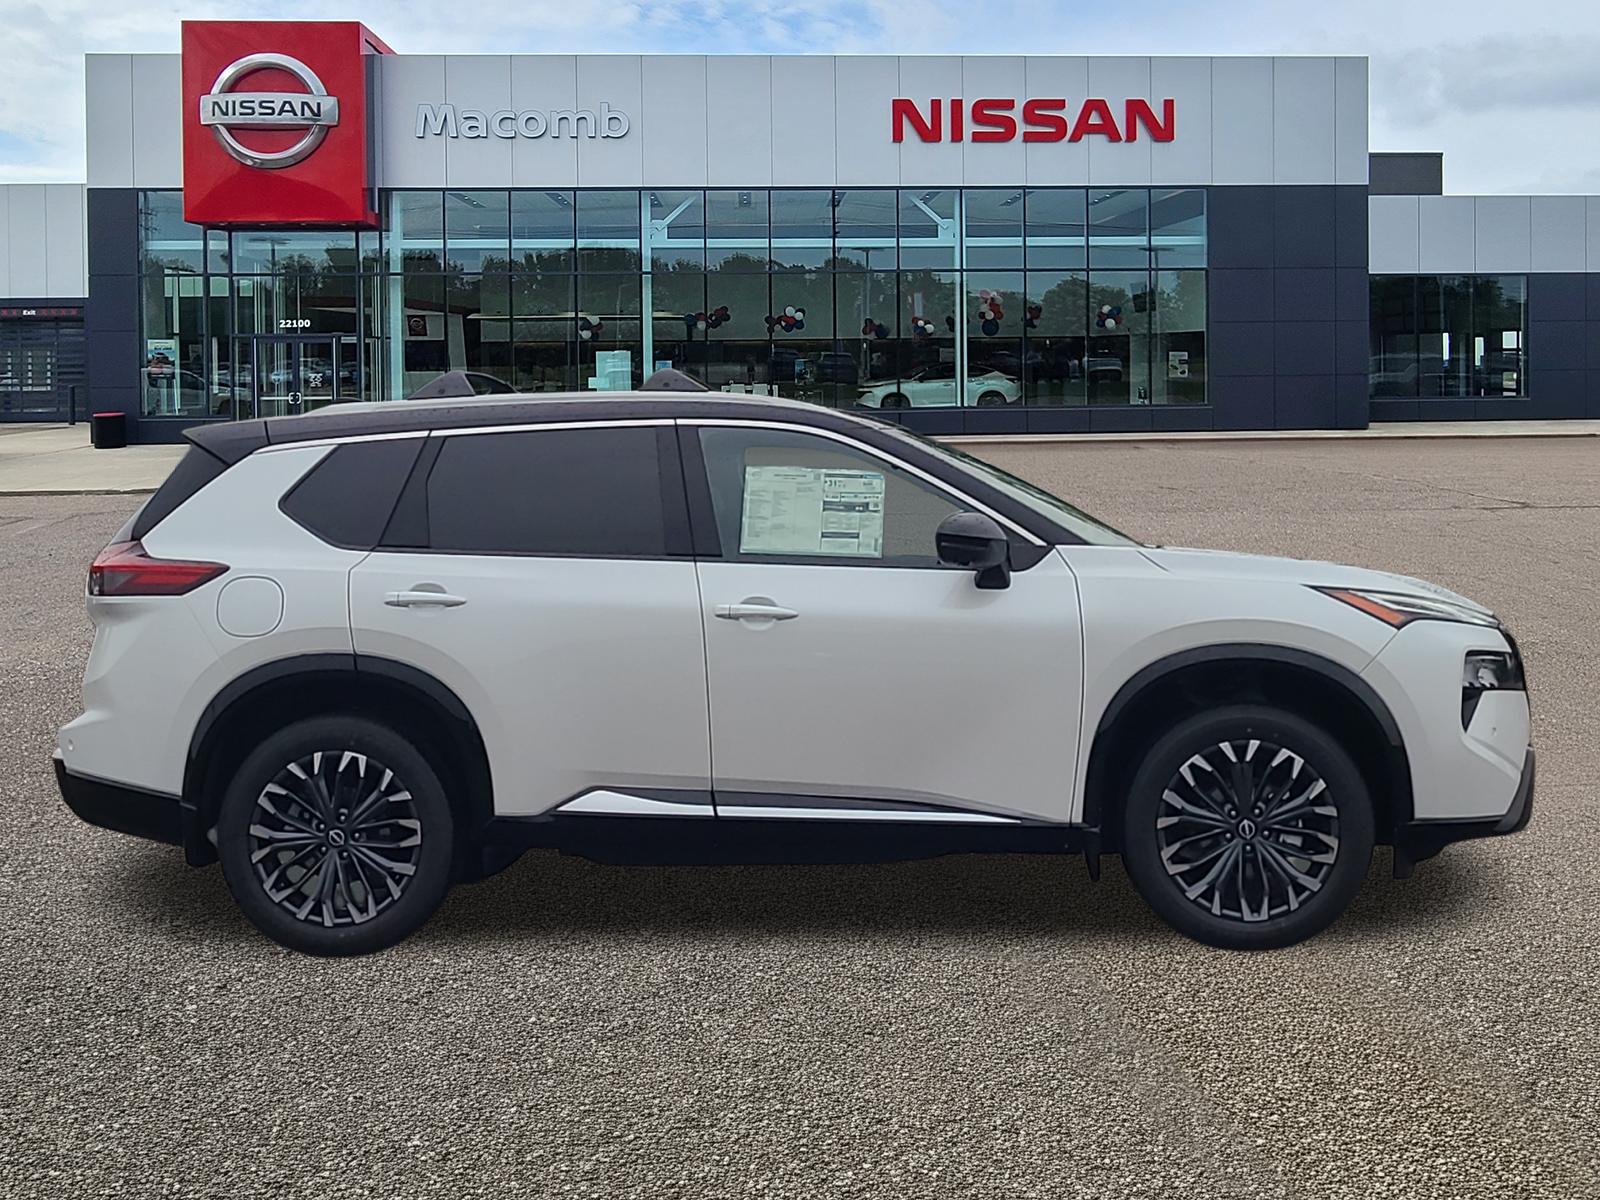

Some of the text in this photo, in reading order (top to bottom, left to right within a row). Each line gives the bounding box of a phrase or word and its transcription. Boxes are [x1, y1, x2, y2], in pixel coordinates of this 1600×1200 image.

[211, 99, 322, 118] NISSAN
[415, 102, 630, 139] Macomb
[892, 98, 1175, 143] NISSAN
[279, 319, 311, 328] 22100
